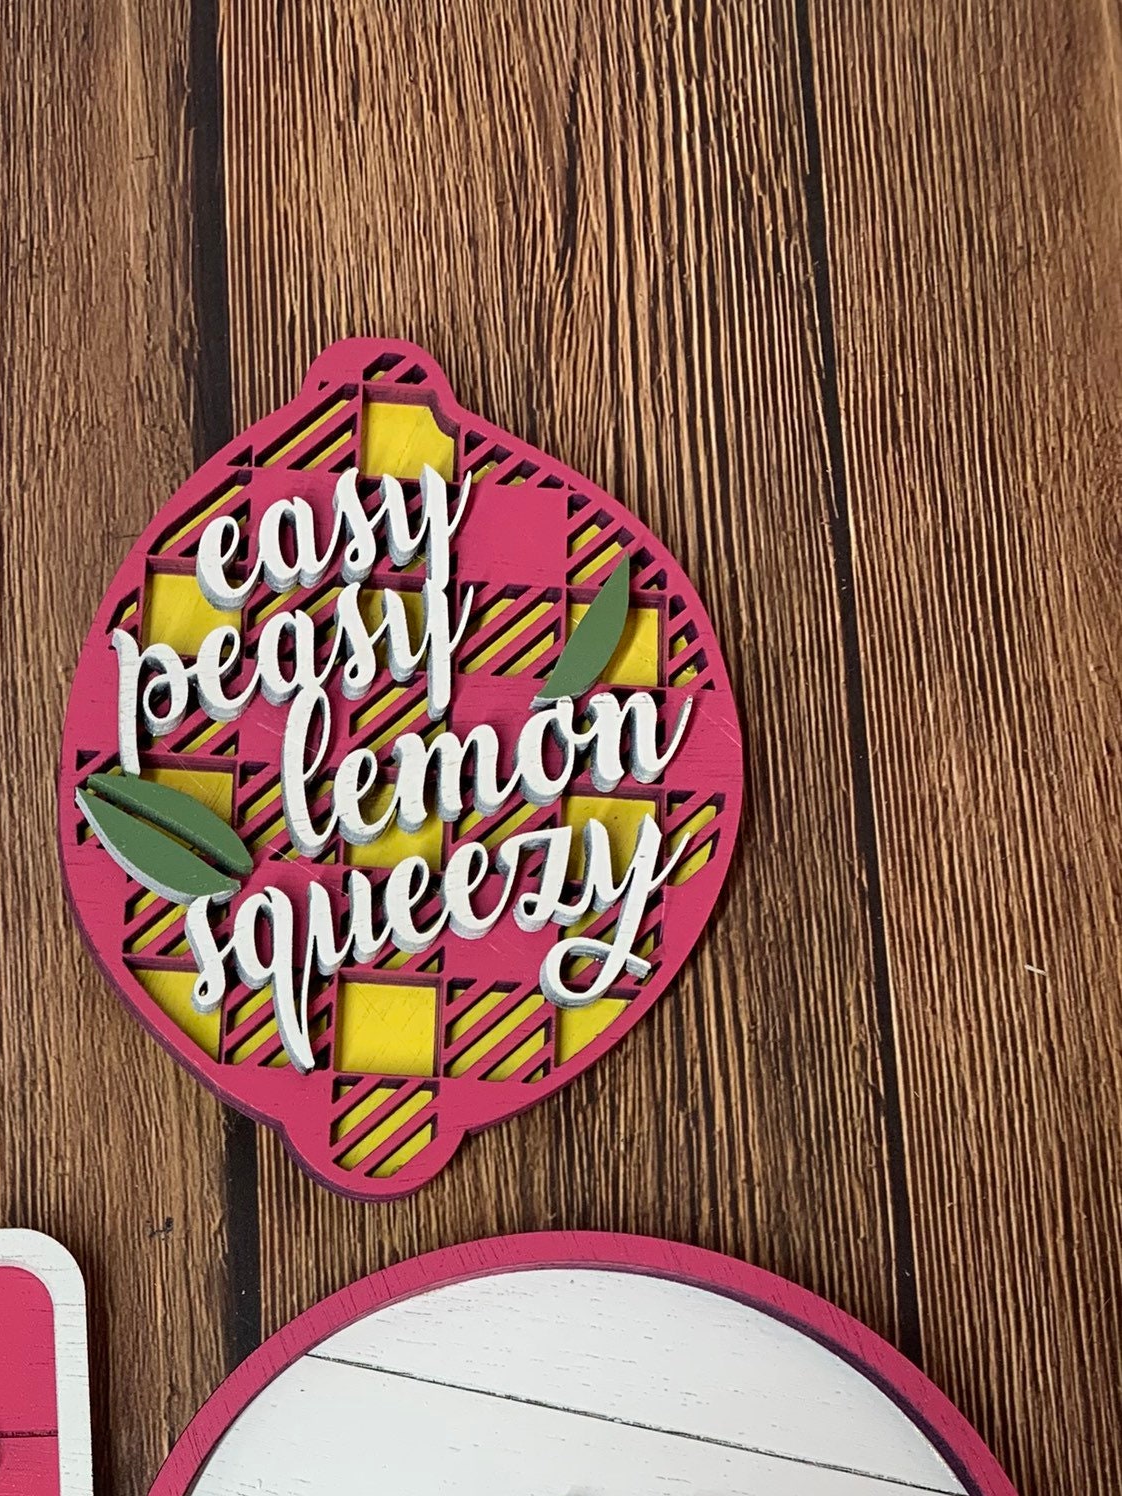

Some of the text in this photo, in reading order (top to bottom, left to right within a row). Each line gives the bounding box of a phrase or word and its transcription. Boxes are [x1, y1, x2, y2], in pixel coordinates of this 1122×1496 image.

[194, 464, 472, 612] easy
[112, 578, 474, 774] peasy
[281, 688, 693, 858] lemon
[184, 812, 689, 1073] squeezy
